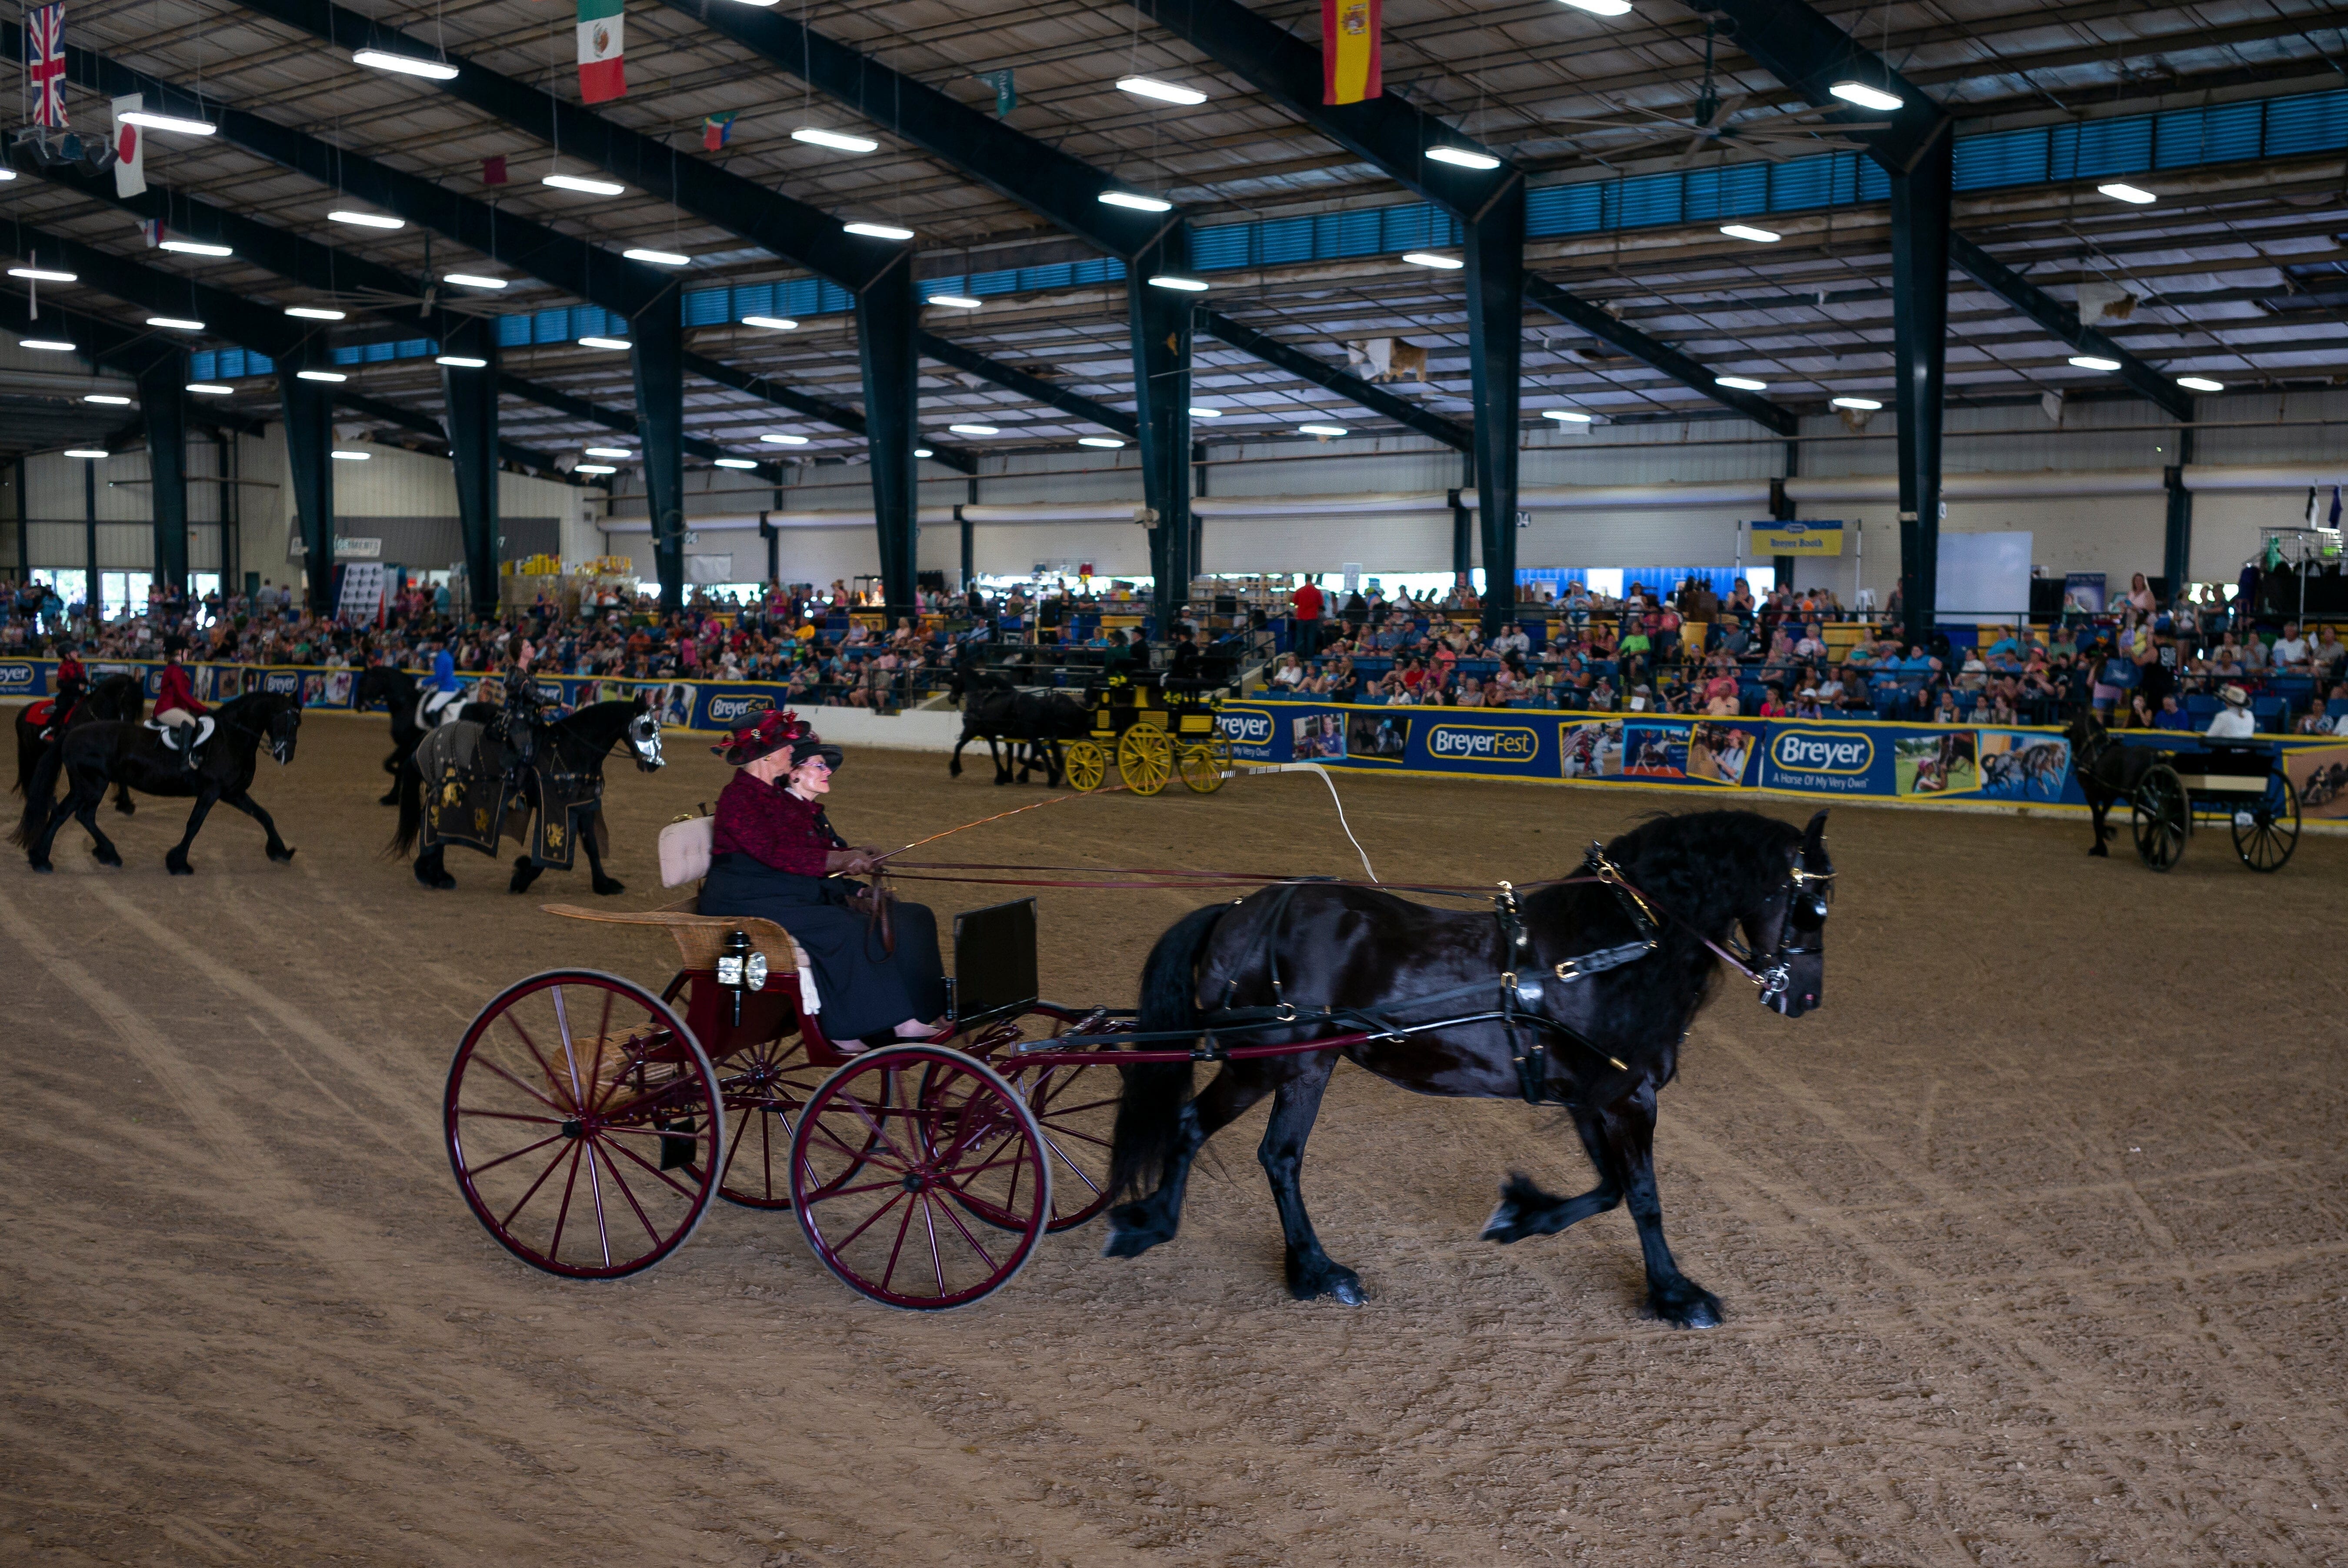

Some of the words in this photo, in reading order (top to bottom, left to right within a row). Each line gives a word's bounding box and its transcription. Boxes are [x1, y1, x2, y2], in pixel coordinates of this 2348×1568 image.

[1436, 730, 1530, 757] BreyerFest
[1782, 736, 1865, 769] Breyer
[1773, 772, 1779, 782] A
[1781, 773, 1802, 785] Horse
[1804, 775, 1815, 786] Of
[1815, 776, 1827, 790] My
[1828, 776, 1847, 790] Very
